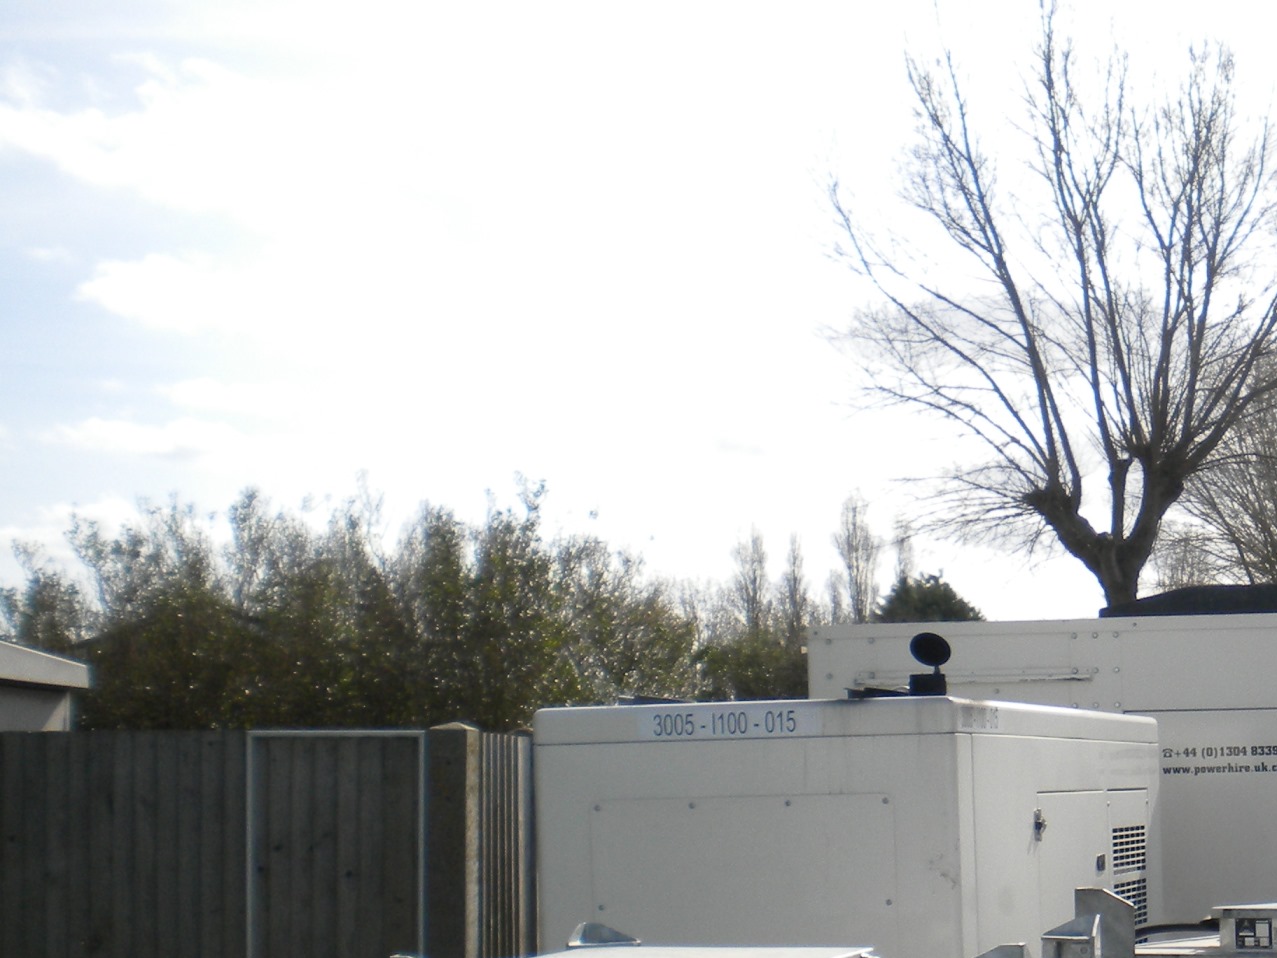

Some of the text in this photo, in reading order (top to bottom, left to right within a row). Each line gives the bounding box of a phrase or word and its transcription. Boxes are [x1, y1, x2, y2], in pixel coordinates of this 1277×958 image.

[652, 712, 696, 737] 3005
[765, 710, 797, 733] 015
[1201, 745, 1248, 760] (0)1304
